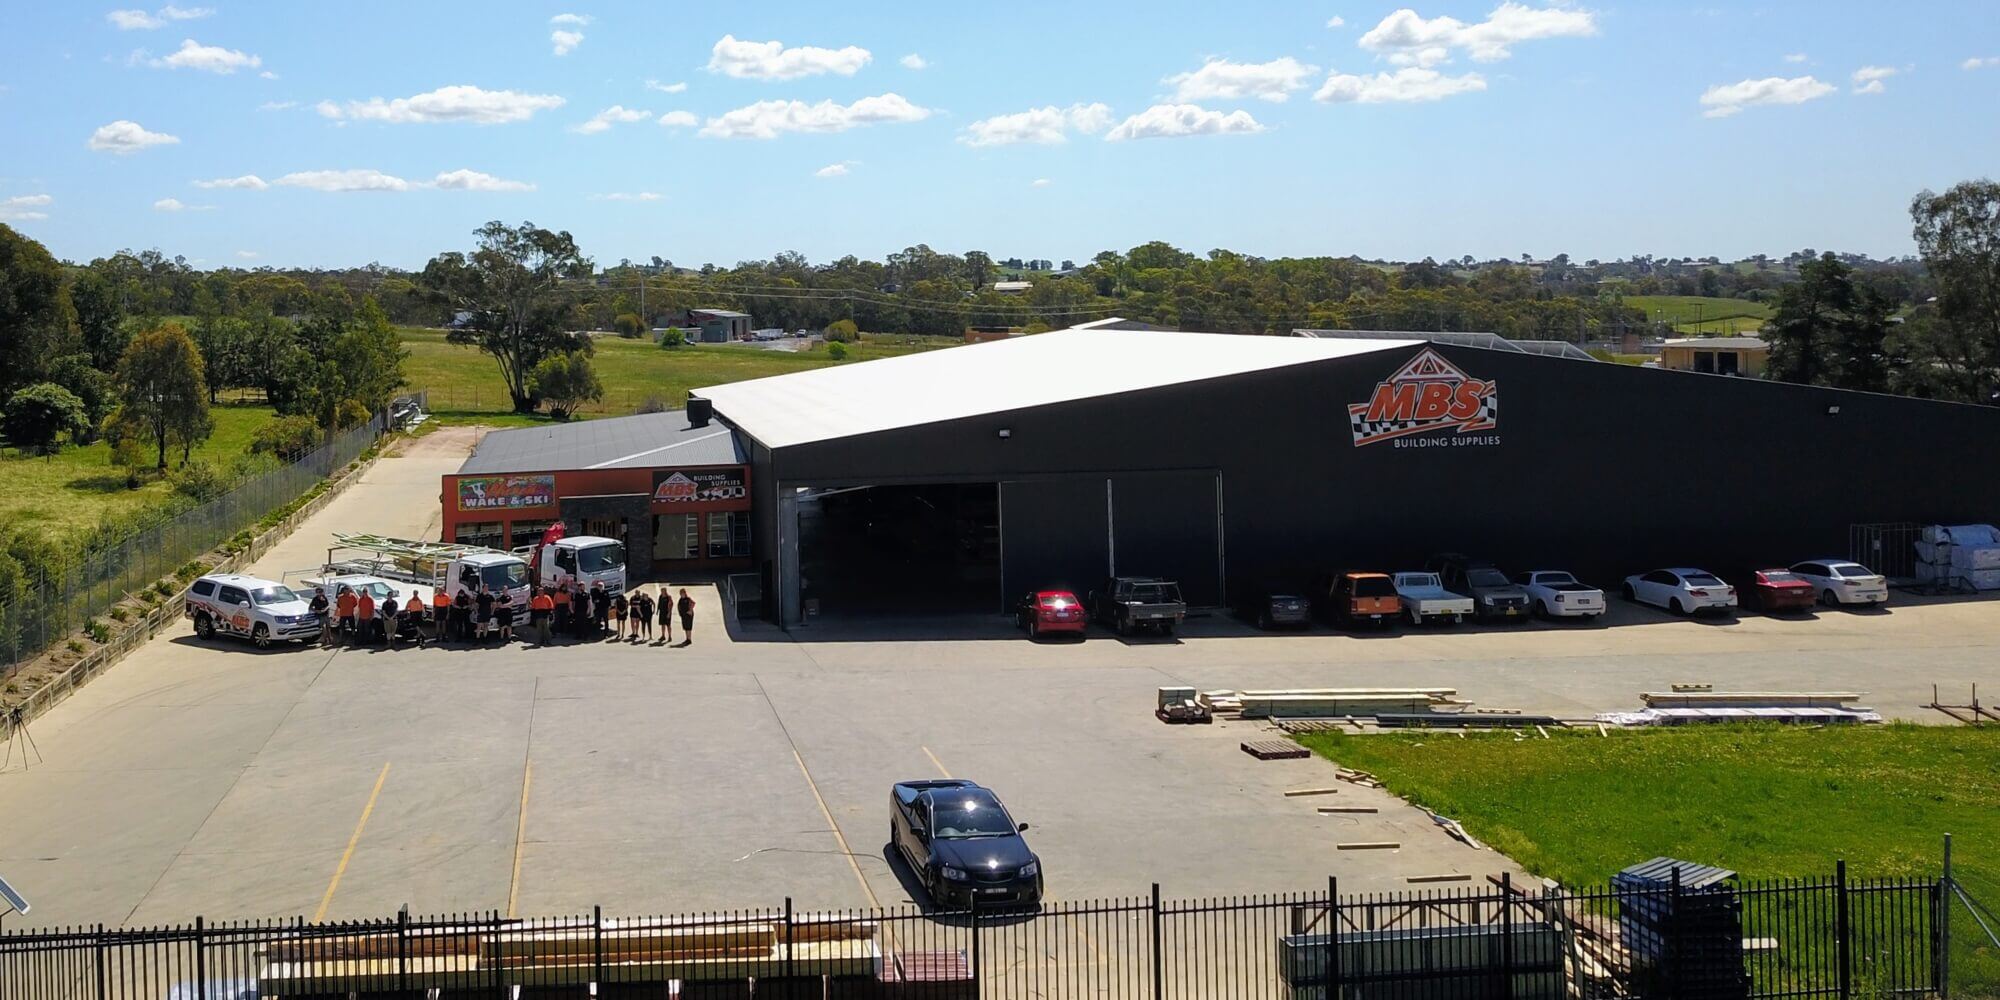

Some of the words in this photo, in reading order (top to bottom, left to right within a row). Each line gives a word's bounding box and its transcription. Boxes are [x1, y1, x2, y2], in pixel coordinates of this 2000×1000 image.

[1365, 381, 1486, 422] MBS
[1394, 437, 1449, 448] BUILDING
[1452, 436, 1501, 447] SUPPLIES
[658, 483, 697, 496] MBS
[465, 497, 506, 507] WAKE
[510, 496, 520, 505] &
[525, 495, 549, 504] SKI
